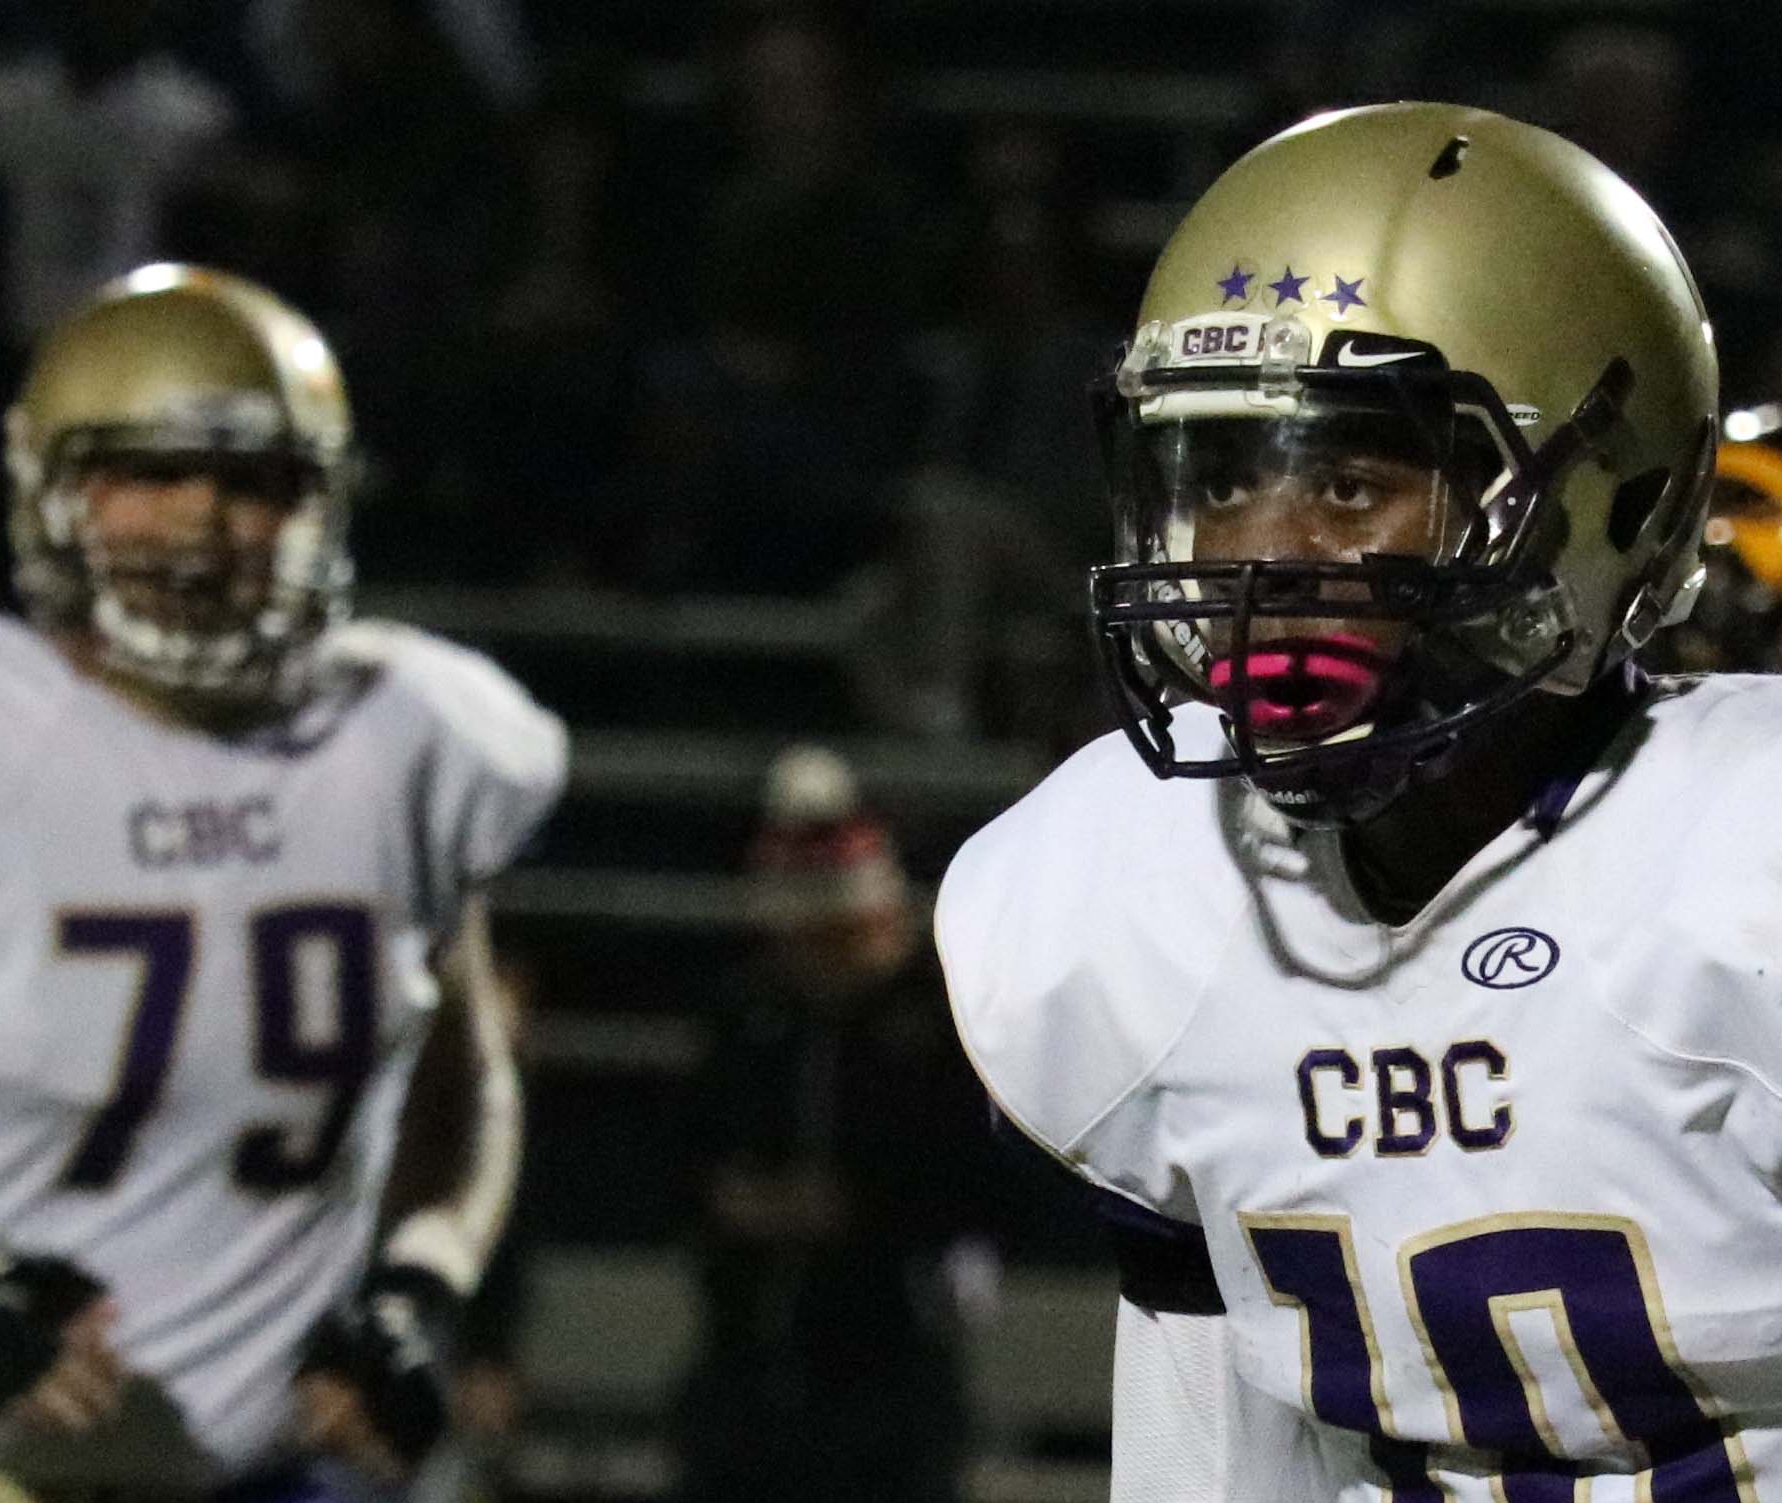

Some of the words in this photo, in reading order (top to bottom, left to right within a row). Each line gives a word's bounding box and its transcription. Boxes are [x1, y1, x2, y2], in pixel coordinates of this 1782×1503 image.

[1182, 325, 1249, 356] CBC
[125, 791, 285, 870] CBC
[51, 896, 379, 1194] 79
[1297, 1040, 1517, 1158] CBC
